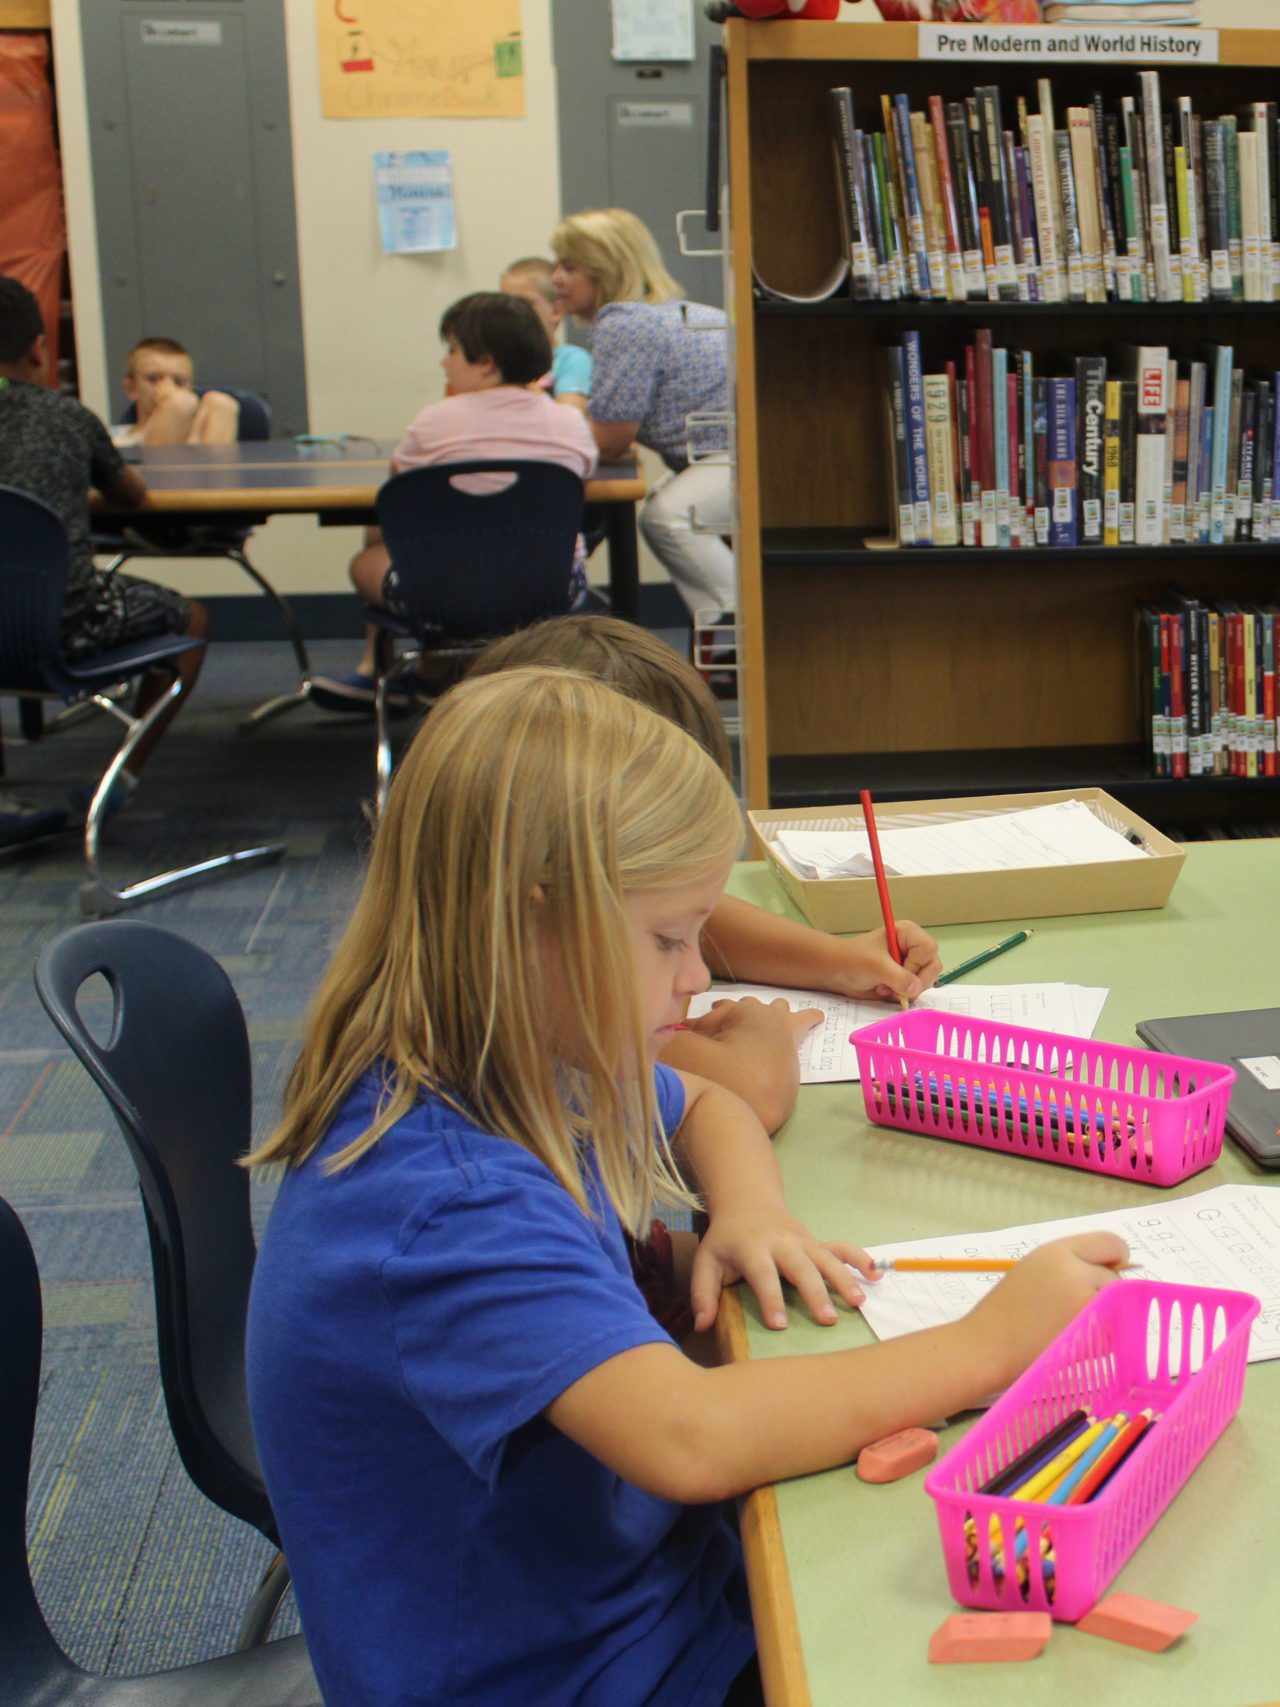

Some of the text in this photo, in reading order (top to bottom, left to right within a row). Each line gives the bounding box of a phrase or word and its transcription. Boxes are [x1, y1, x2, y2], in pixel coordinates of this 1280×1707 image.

[937, 34, 1202, 57] Pre Modern and World History
[924, 379, 949, 424] 1929
[1143, 368, 1161, 407] LIFE
[905, 340, 928, 498] WONDERS OF THE WORLD
[1055, 382, 1068, 459] THE SILK ROADS
[1106, 444, 1119, 468] 1968
[1245, 440, 1254, 480] TITANIC
[1190, 654, 1200, 729] HITLER YOUTH
